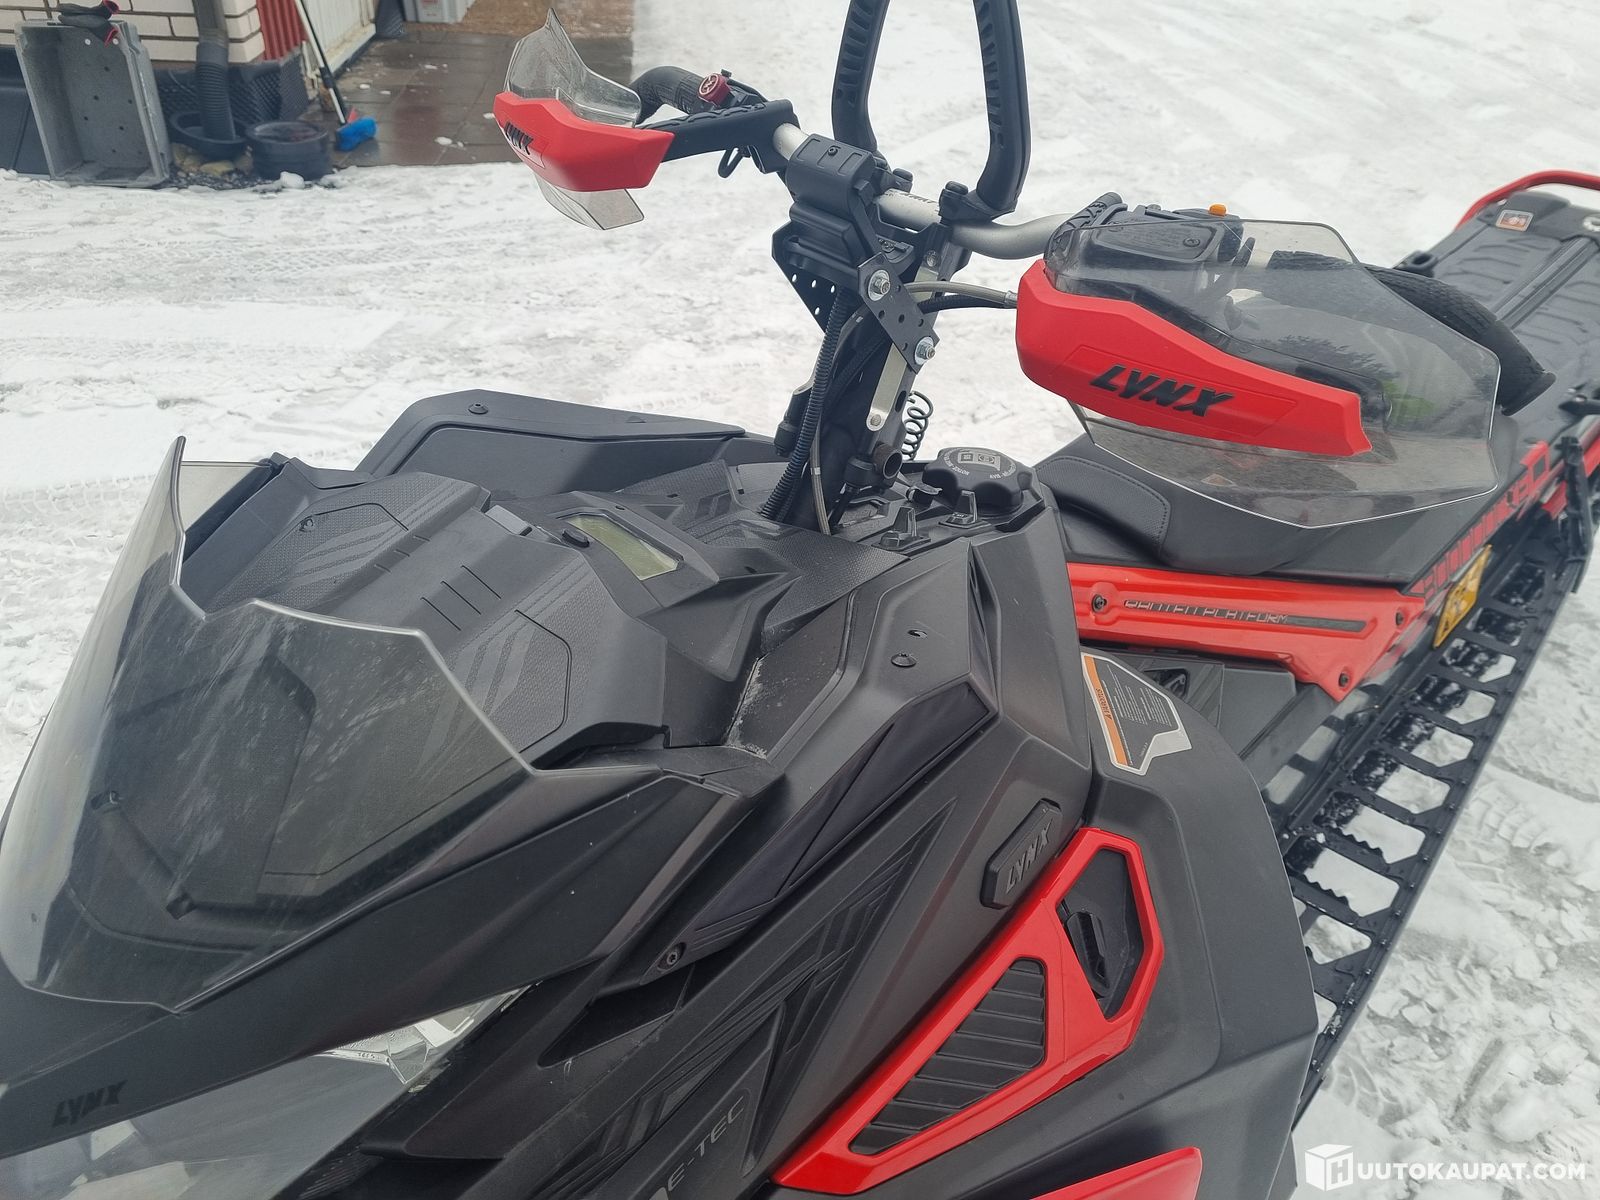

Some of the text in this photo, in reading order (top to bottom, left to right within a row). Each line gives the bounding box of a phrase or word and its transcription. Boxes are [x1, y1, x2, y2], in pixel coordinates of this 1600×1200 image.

[1089, 363, 1235, 418] LYNX
[1202, 606, 1289, 624] PLATFORM
[1006, 818, 1054, 894] LYNX
[52, 1079, 128, 1128] LYNX
[667, 1095, 744, 1192] E-TEC
